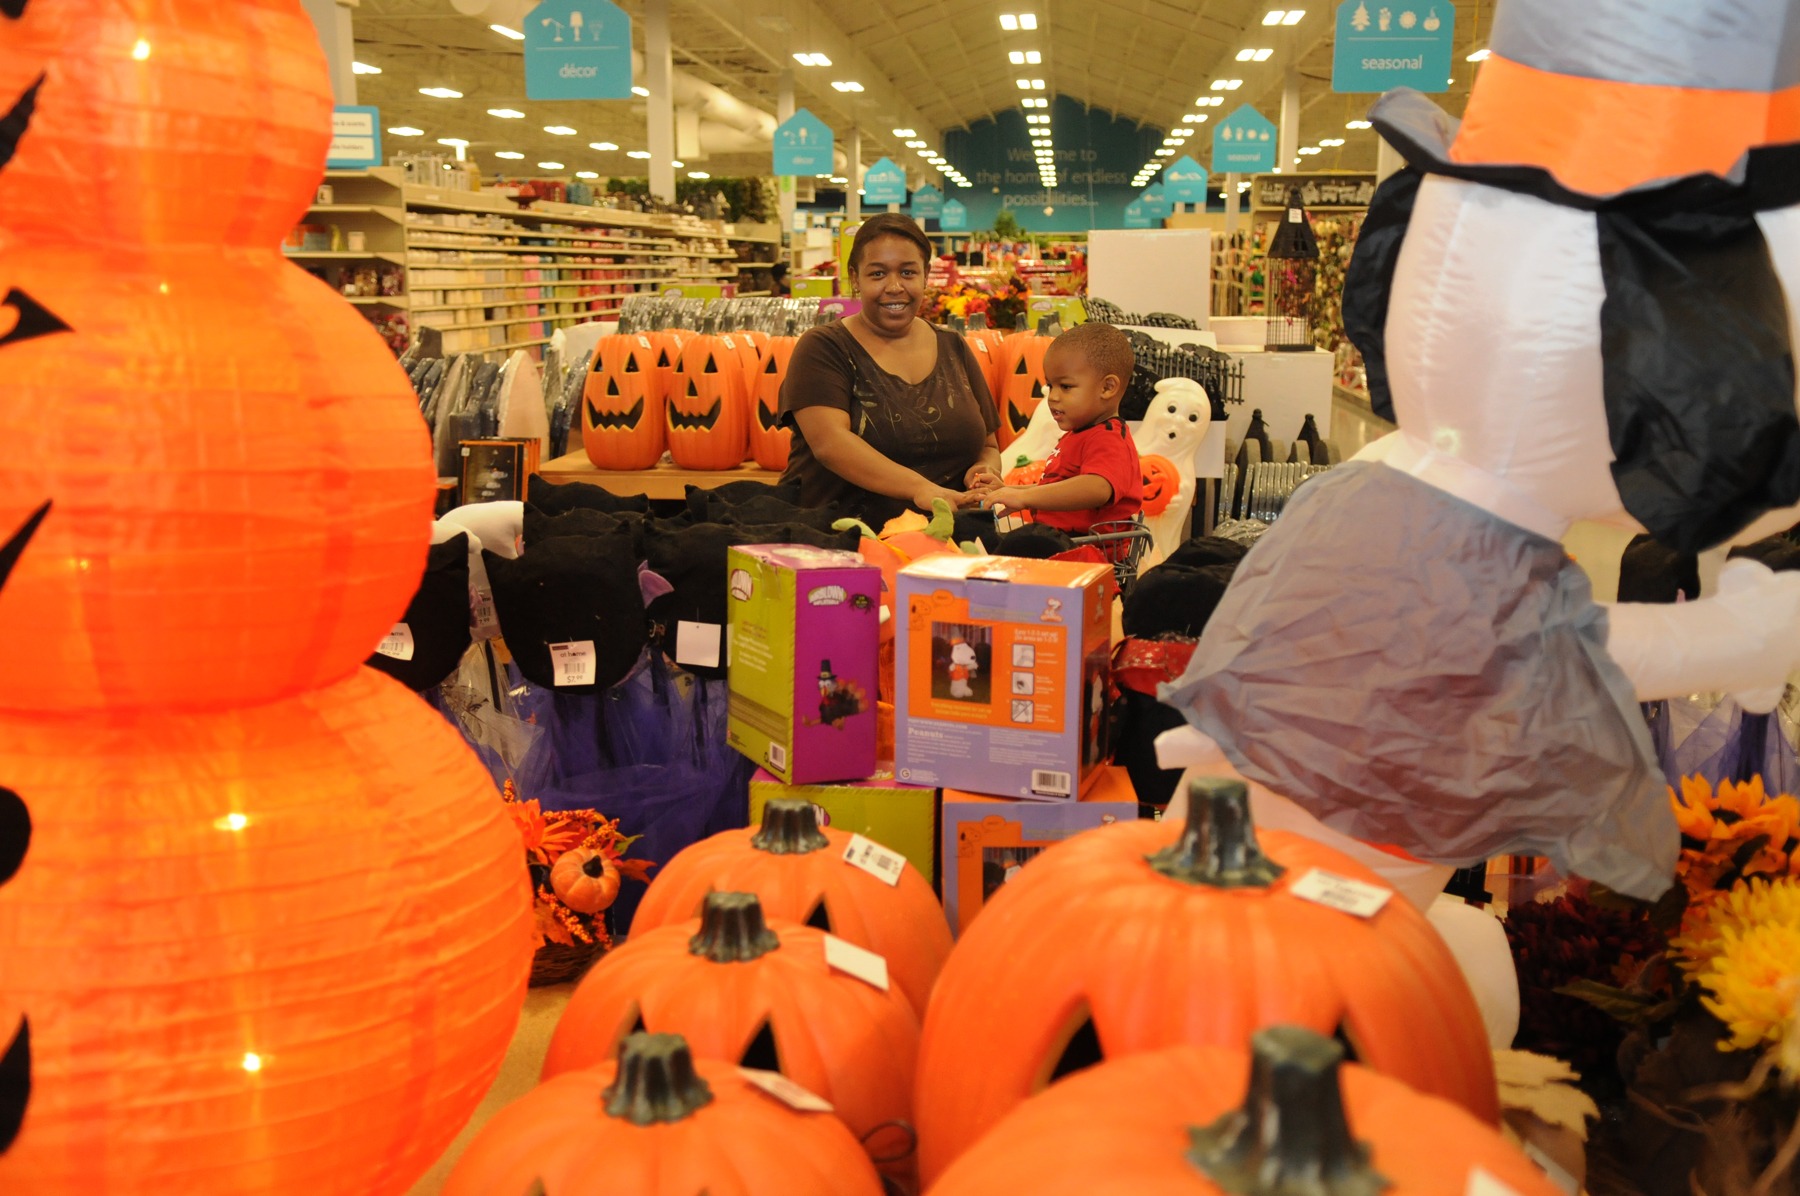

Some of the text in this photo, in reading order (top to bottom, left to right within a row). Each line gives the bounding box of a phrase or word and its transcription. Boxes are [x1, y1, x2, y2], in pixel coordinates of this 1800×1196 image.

[1361, 54, 1423, 70] seasonal
[559, 63, 598, 79] décor
[1007, 147, 1098, 162] Weme to
[976, 169, 1001, 184] the
[1004, 168, 1046, 184] hom
[1072, 168, 1128, 184] endless
[908, 727, 944, 739] Peanuts
